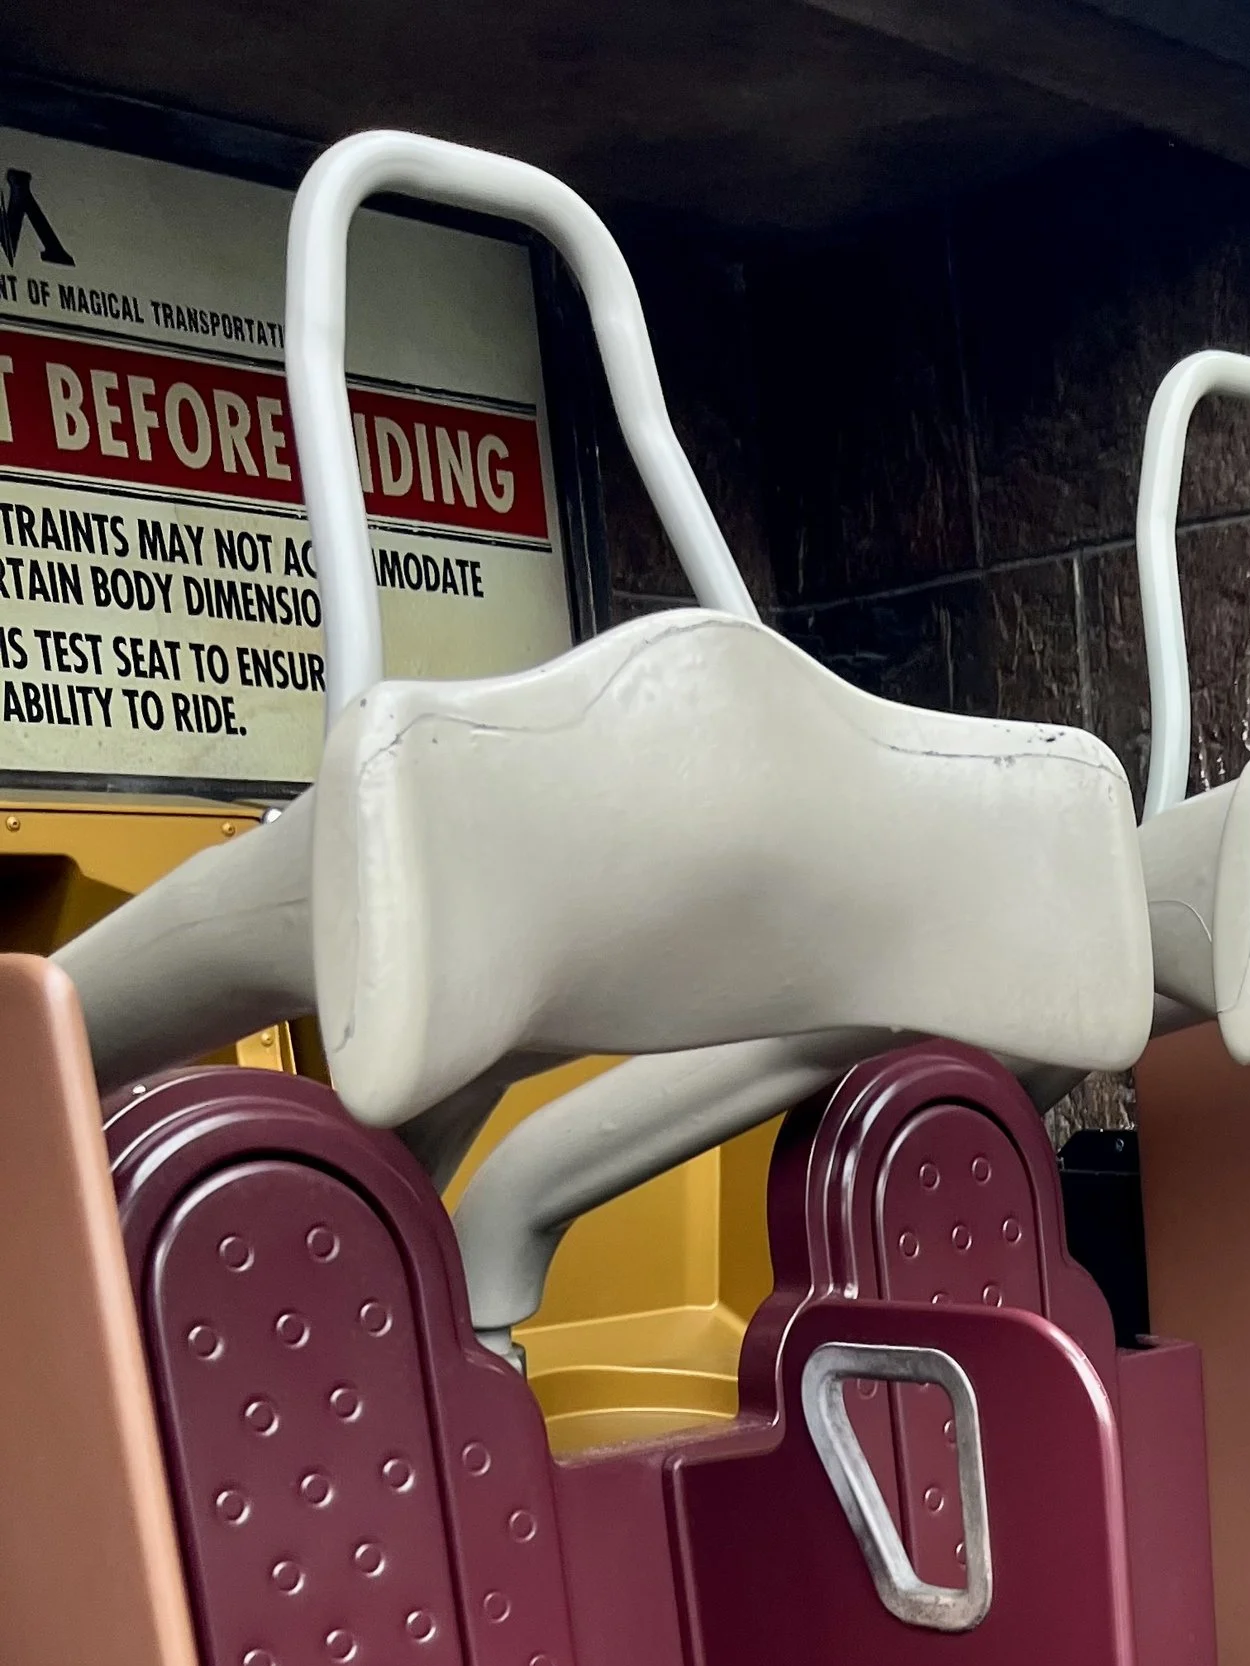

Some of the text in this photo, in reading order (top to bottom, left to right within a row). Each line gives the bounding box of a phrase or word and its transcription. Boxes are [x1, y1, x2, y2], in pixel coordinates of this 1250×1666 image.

[27, 278, 50, 307] OF
[58, 284, 145, 324] MAGICAL
[150, 301, 285, 349] TRANSPORTATI
[46, 362, 292, 481] BEFORE
[353, 412, 515, 514] IDING
[137, 518, 205, 567] MAY
[214, 528, 273, 574] NOT
[284, 537, 485, 598] ACMODATE
[90, 565, 173, 614] BODY
[183, 575, 322, 628] DIMENSIO
[33, 629, 103, 676] TEST
[113, 636, 181, 681] SEAT
[189, 642, 229, 685] TO
[236, 647, 326, 693] ENSUR
[4, 680, 247, 736] ABILITY TO RIDE.
